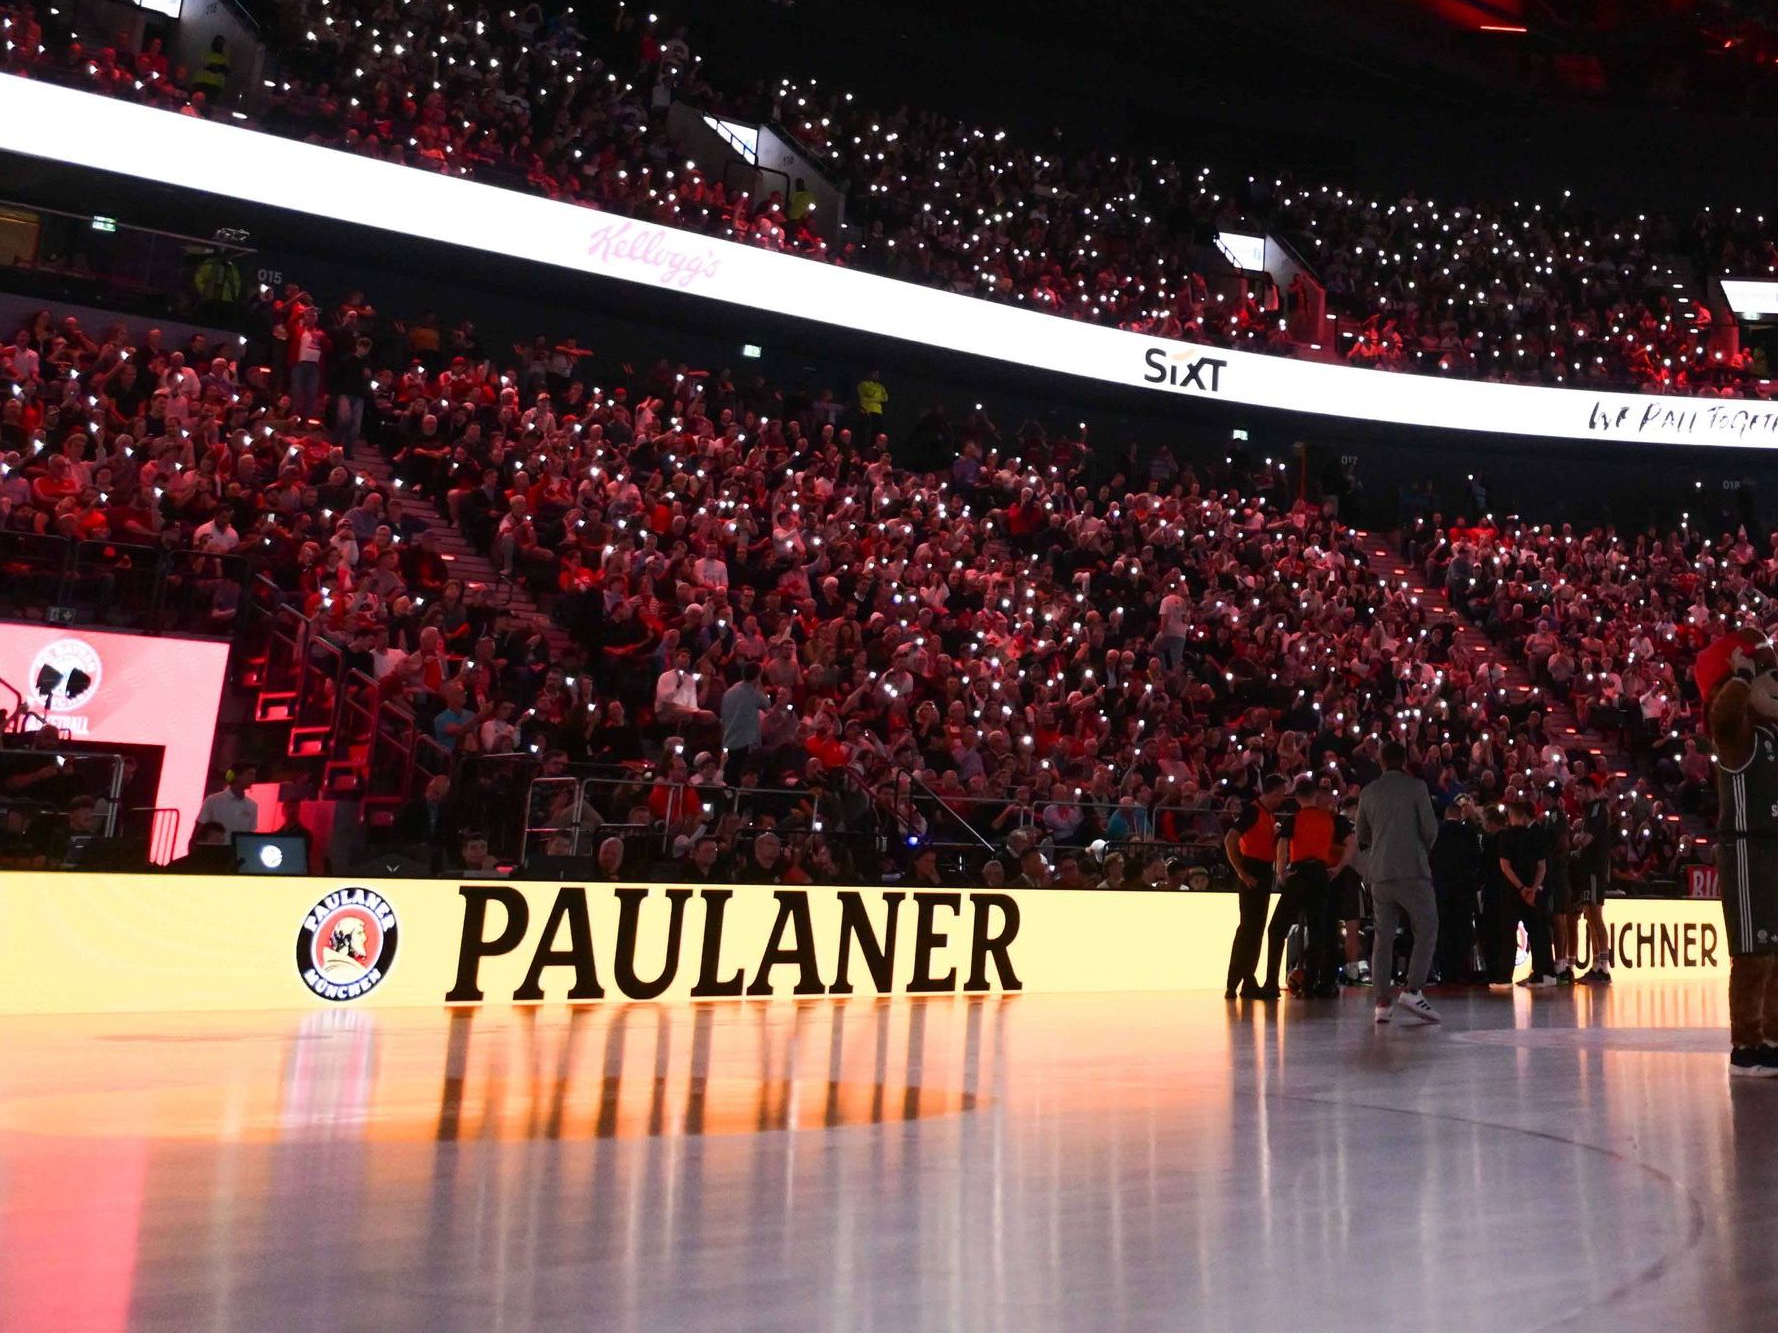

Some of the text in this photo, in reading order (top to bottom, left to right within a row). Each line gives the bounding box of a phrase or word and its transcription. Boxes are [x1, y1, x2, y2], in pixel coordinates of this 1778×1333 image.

[588, 221, 720, 287] Kellogg's
[258, 268, 282, 285] 015
[1589, 401, 1631, 430] WE
[303, 887, 396, 933] PAULANER
[445, 885, 1023, 1003] PAULANER
[303, 967, 381, 1000] MÜNCHEN
